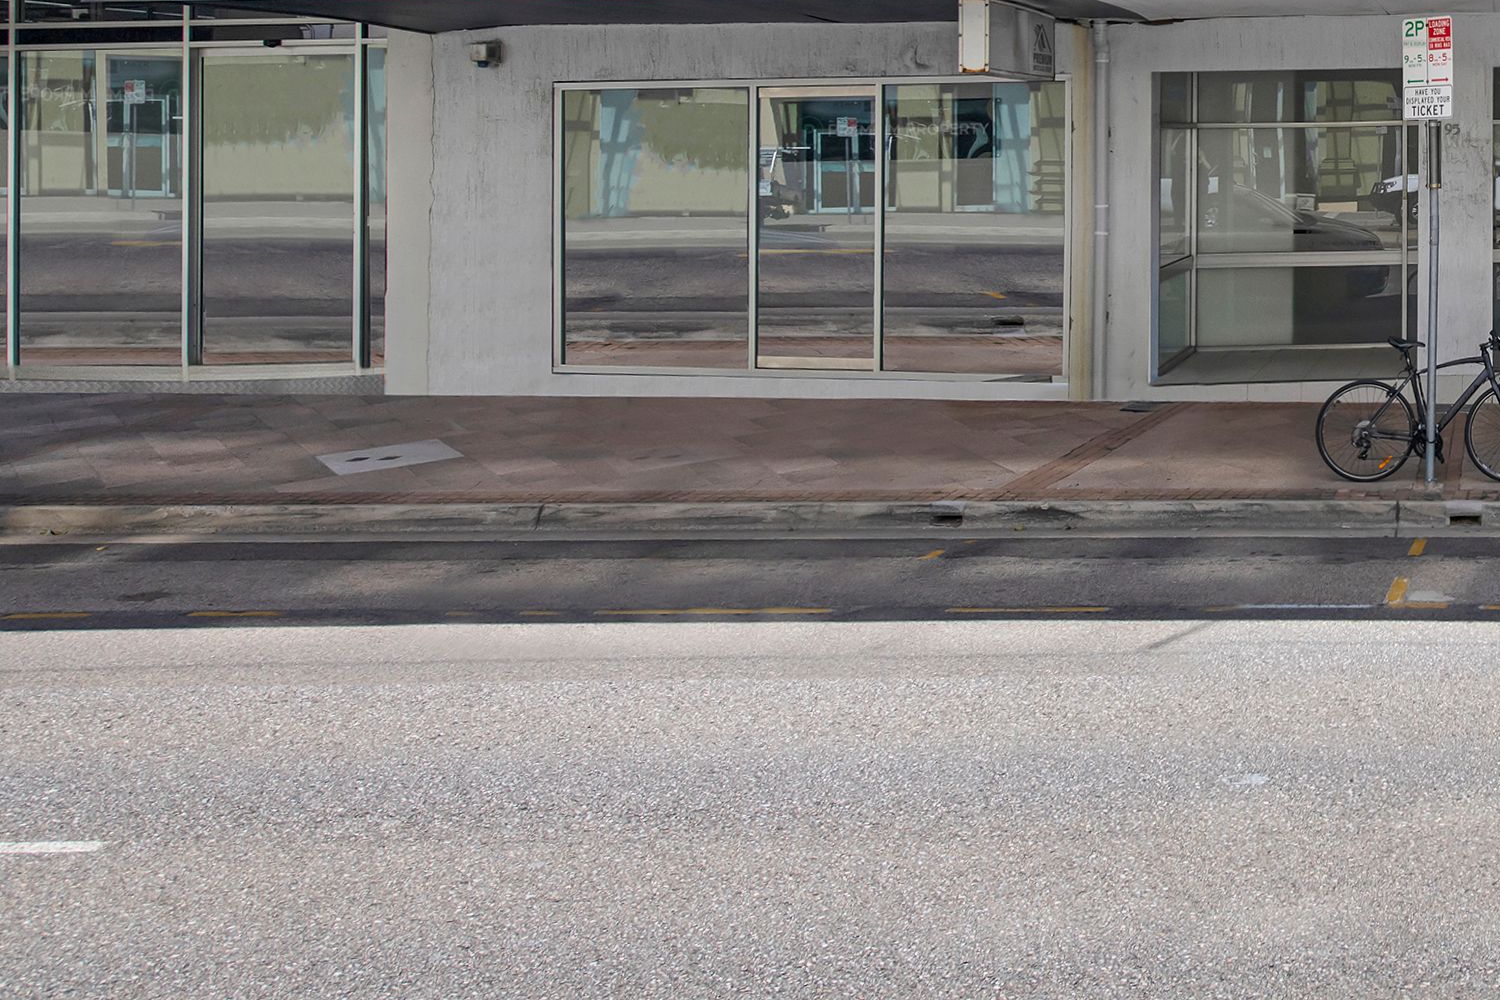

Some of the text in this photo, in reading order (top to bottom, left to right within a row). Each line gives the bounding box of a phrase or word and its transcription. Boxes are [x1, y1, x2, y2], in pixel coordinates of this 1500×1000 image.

[1405, 20, 1425, 37] 2P
[1406, 97, 1434, 105] DISPLAYED
[1412, 105, 1444, 116] TICKET
[1444, 123, 1461, 136] 95
